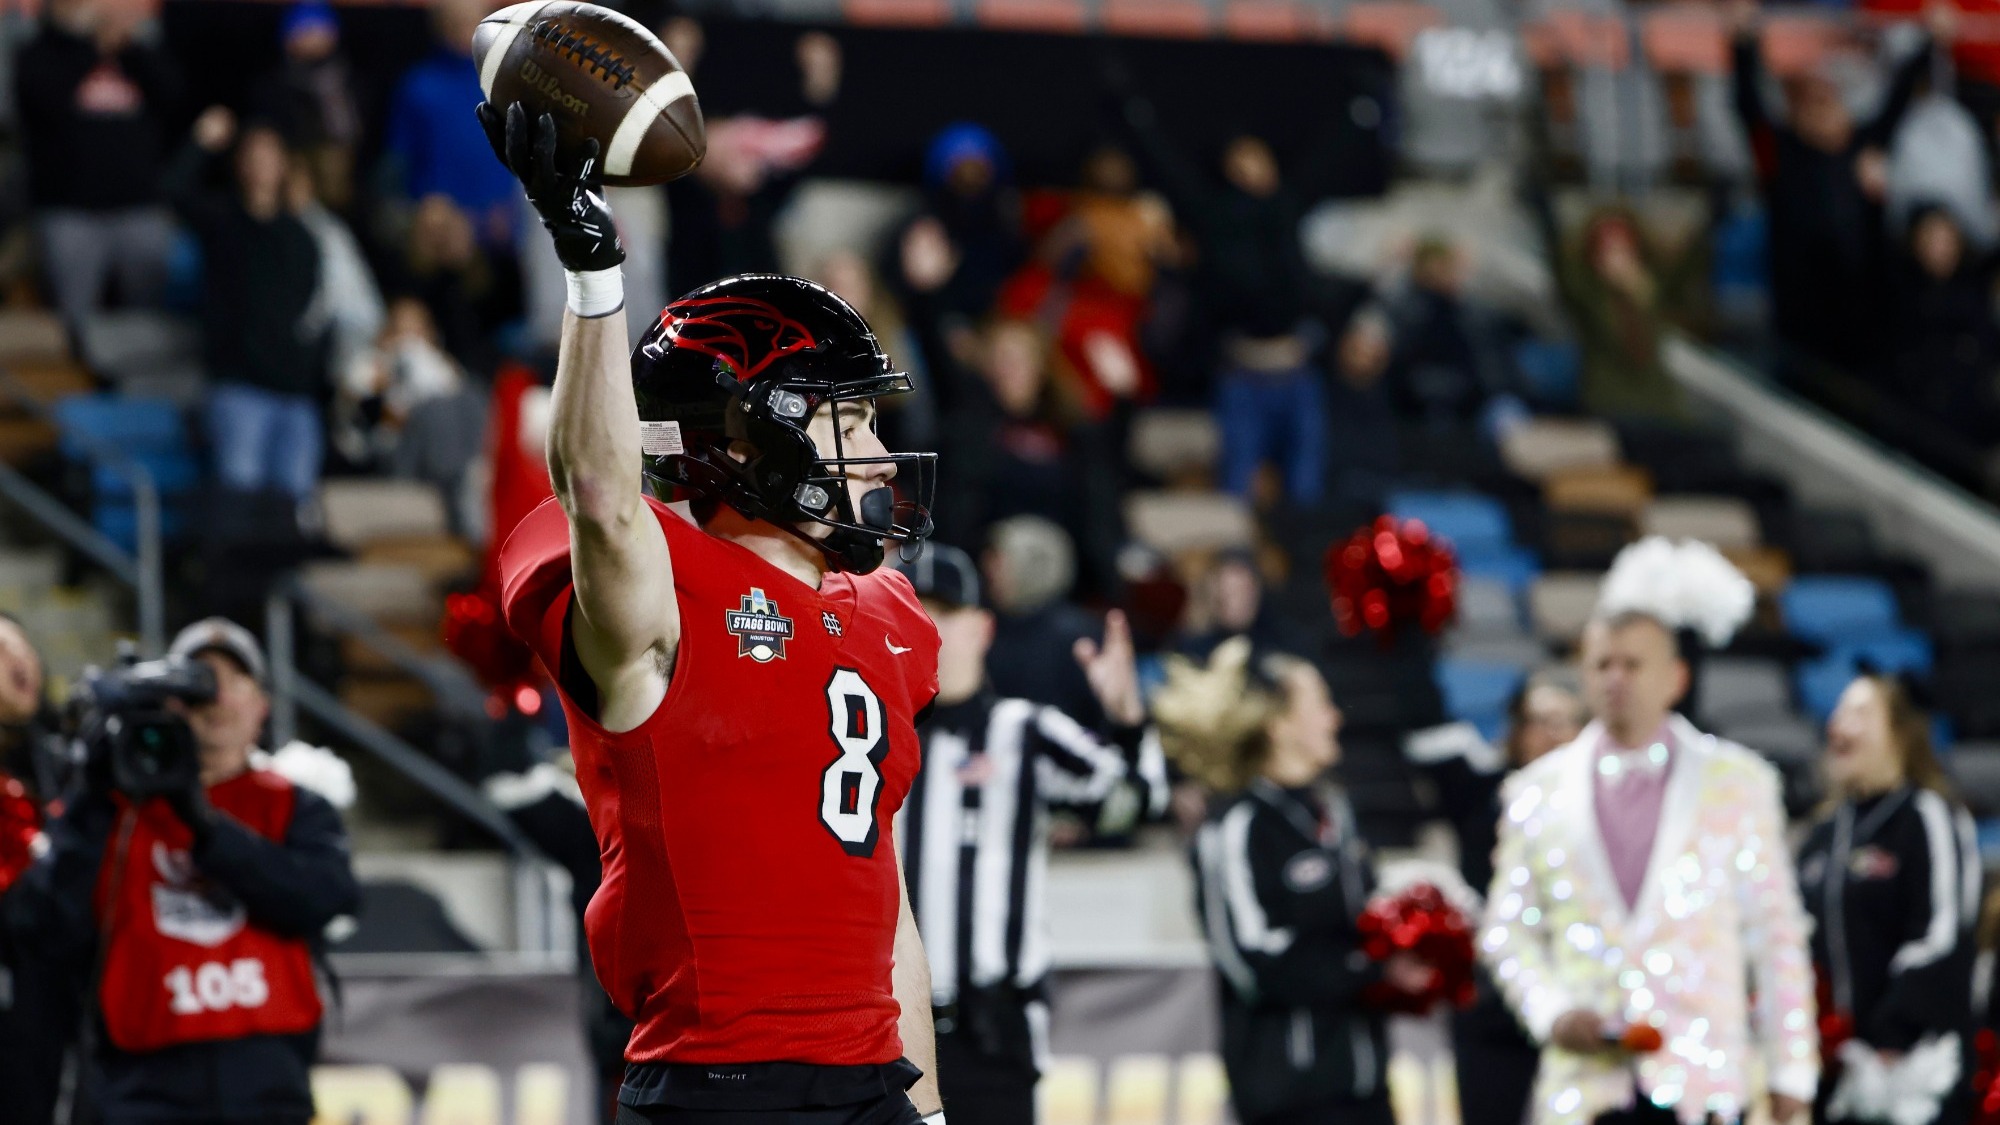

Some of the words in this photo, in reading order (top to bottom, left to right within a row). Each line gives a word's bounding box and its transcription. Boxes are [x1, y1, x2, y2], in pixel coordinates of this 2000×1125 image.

[519, 58, 590, 116] Wilson
[733, 616, 764, 631] STAGG
[764, 619, 789, 634] BOWL
[750, 634, 774, 642] HOUSTON
[818, 665, 889, 857] 8
[163, 957, 269, 1015] 105
[708, 1072, 746, 1080] DRI-FIT
